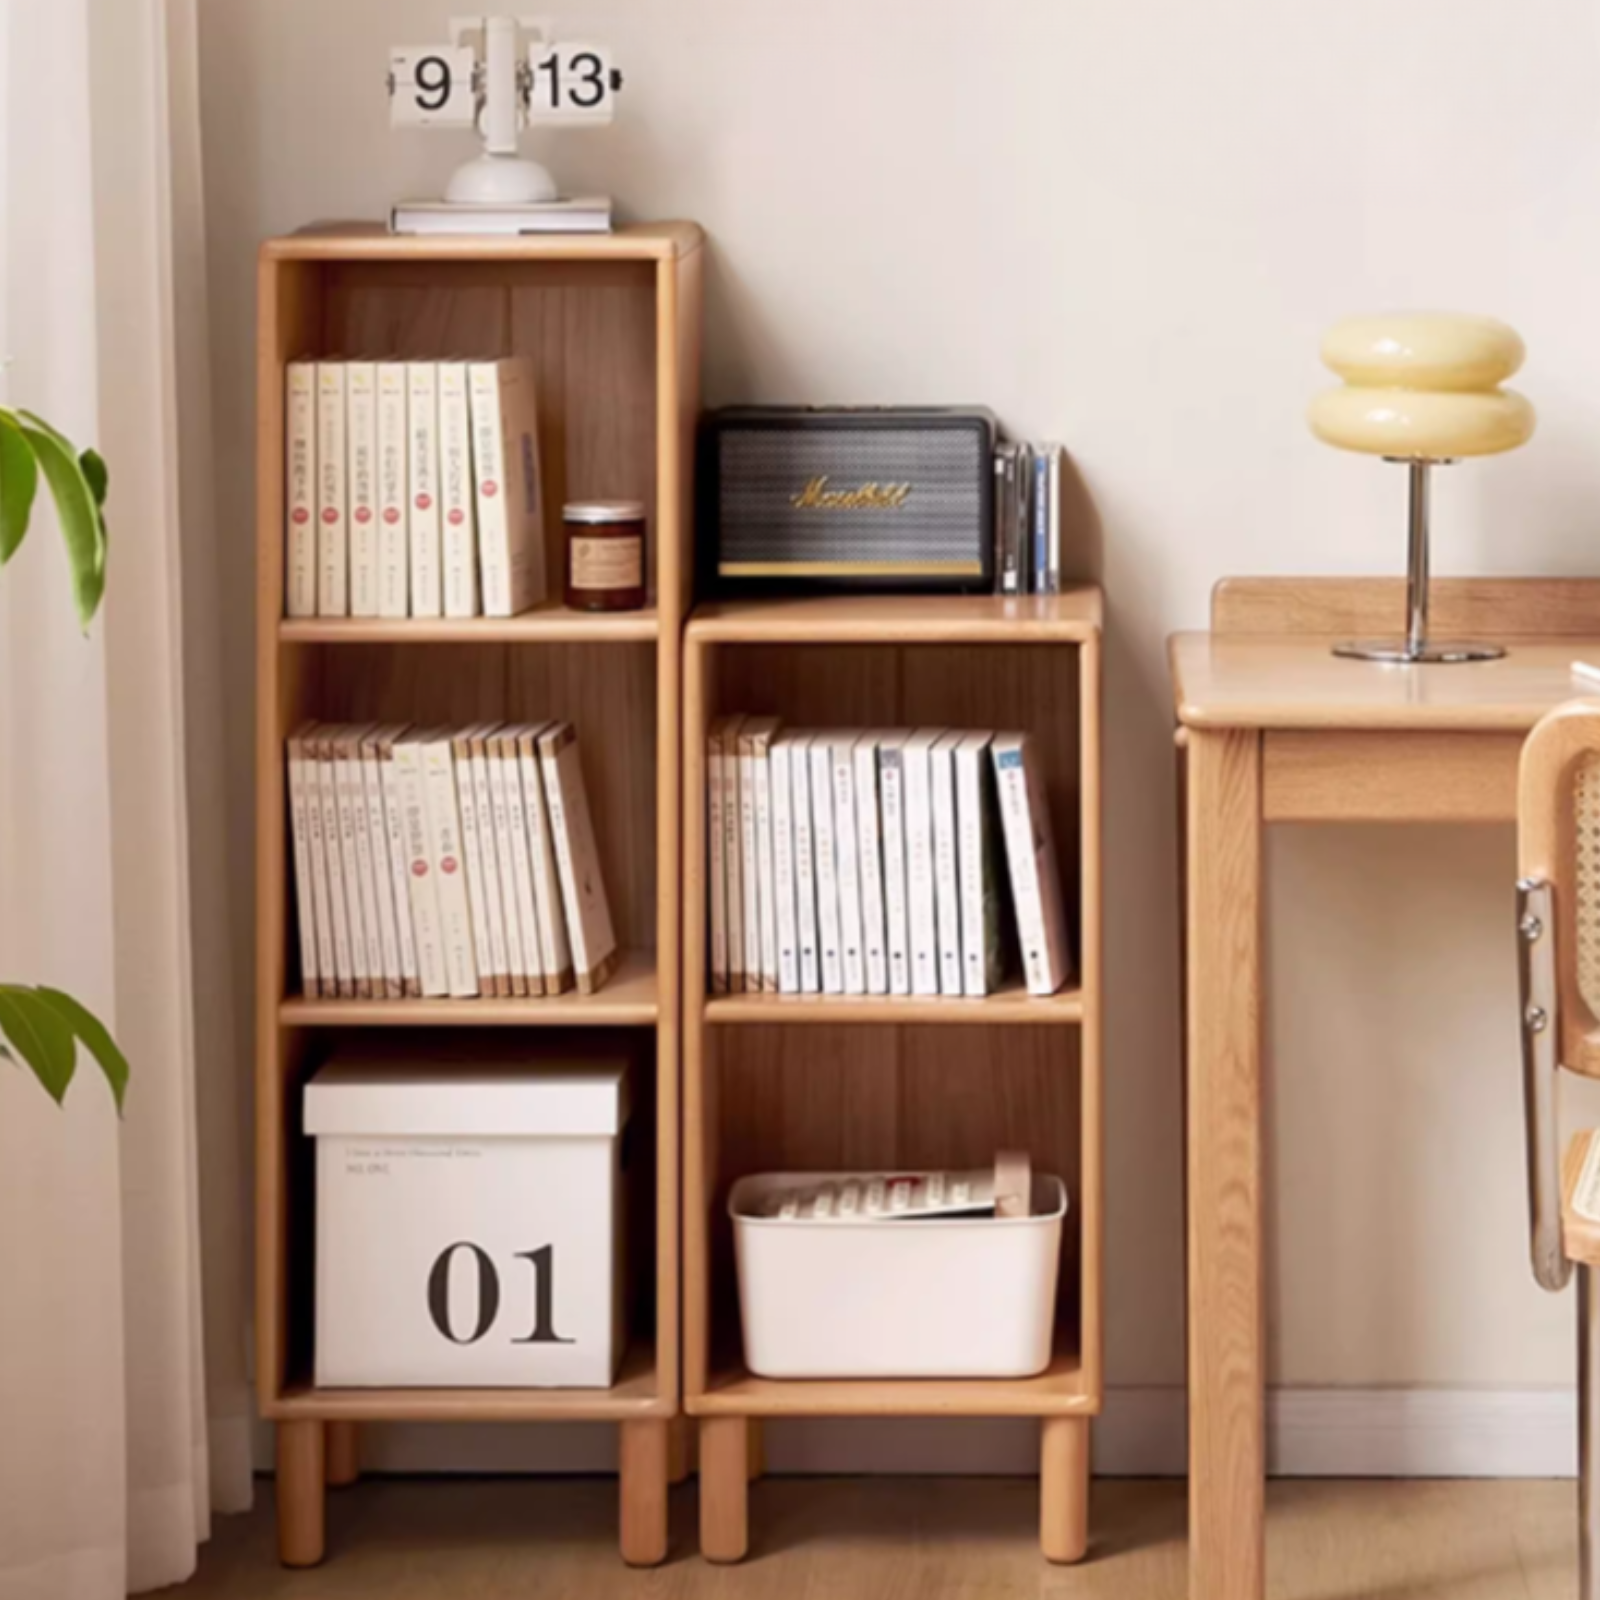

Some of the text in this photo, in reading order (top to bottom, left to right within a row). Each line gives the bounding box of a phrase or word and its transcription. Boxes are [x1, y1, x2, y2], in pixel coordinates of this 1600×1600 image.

[414, 52, 604, 111] 9 13
[427, 1241, 577, 1345] 01
